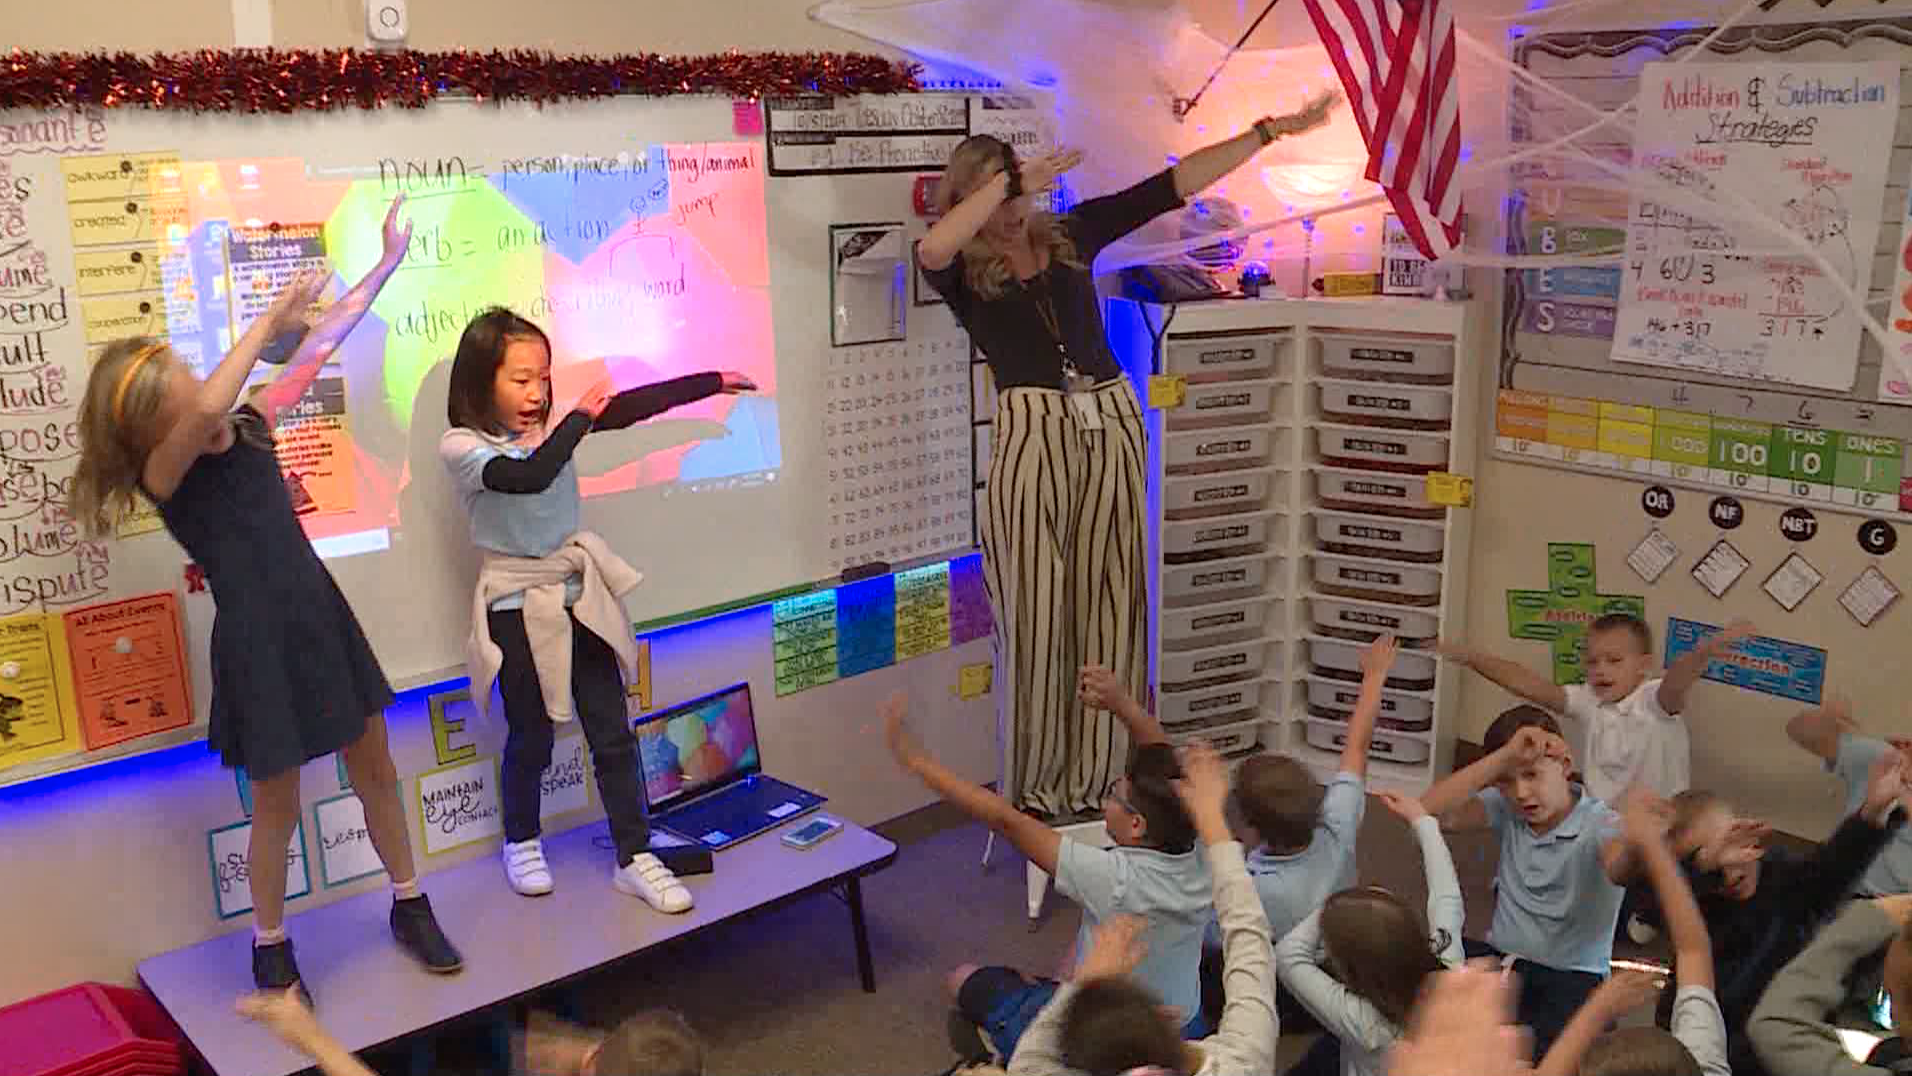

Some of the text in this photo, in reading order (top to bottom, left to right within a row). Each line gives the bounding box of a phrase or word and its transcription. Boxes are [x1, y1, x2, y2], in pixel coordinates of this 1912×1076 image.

[398, 225, 453, 263] erb
[1783, 427, 1827, 447] TENS
[1718, 443, 1768, 467] 100
[1788, 450, 1821, 476] 10
[1713, 503, 1739, 521] NF
[1780, 515, 1816, 536] NBT
[1869, 528, 1885, 546] G
[422, 775, 485, 806] MAINTAIN
